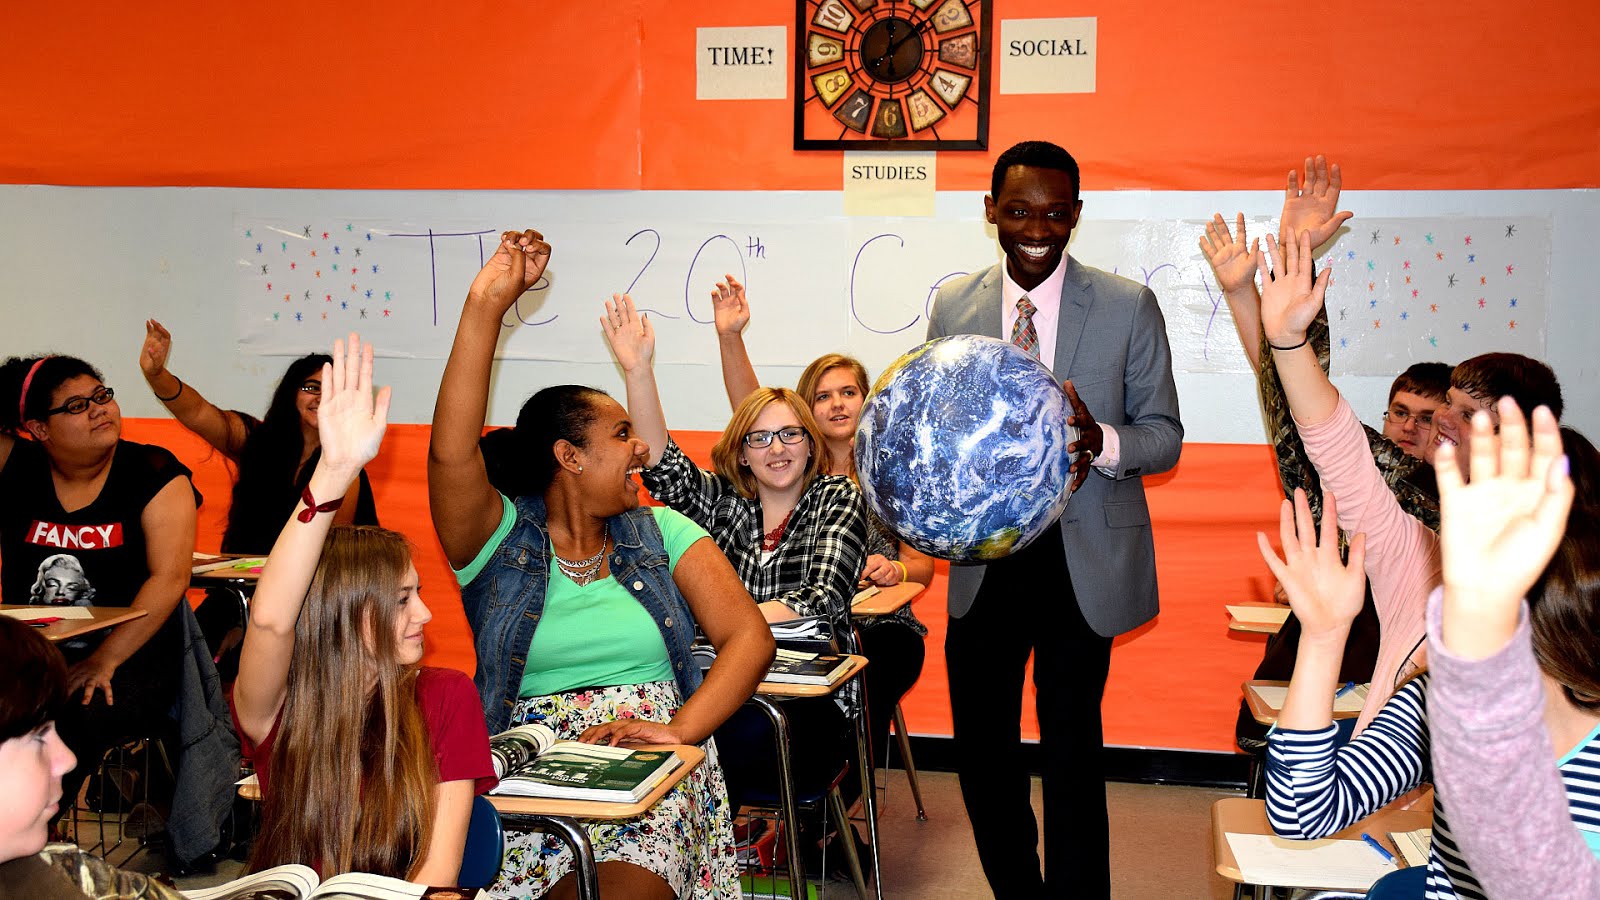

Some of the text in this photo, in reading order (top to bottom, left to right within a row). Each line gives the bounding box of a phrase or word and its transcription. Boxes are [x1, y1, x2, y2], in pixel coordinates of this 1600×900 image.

[822, 3, 846, 30] 10
[707, 46, 774, 66] TIME!
[817, 42, 838, 56] 9
[1009, 39, 1088, 57] SOCIAL
[825, 74, 846, 93] 8
[938, 75, 959, 94] 4
[851, 97, 869, 119] 7
[913, 94, 929, 118] 5
[883, 106, 897, 128] 6
[851, 165, 927, 181] STUDIES
[388, 228, 559, 327] Te
[32, 521, 114, 549] FANCY
